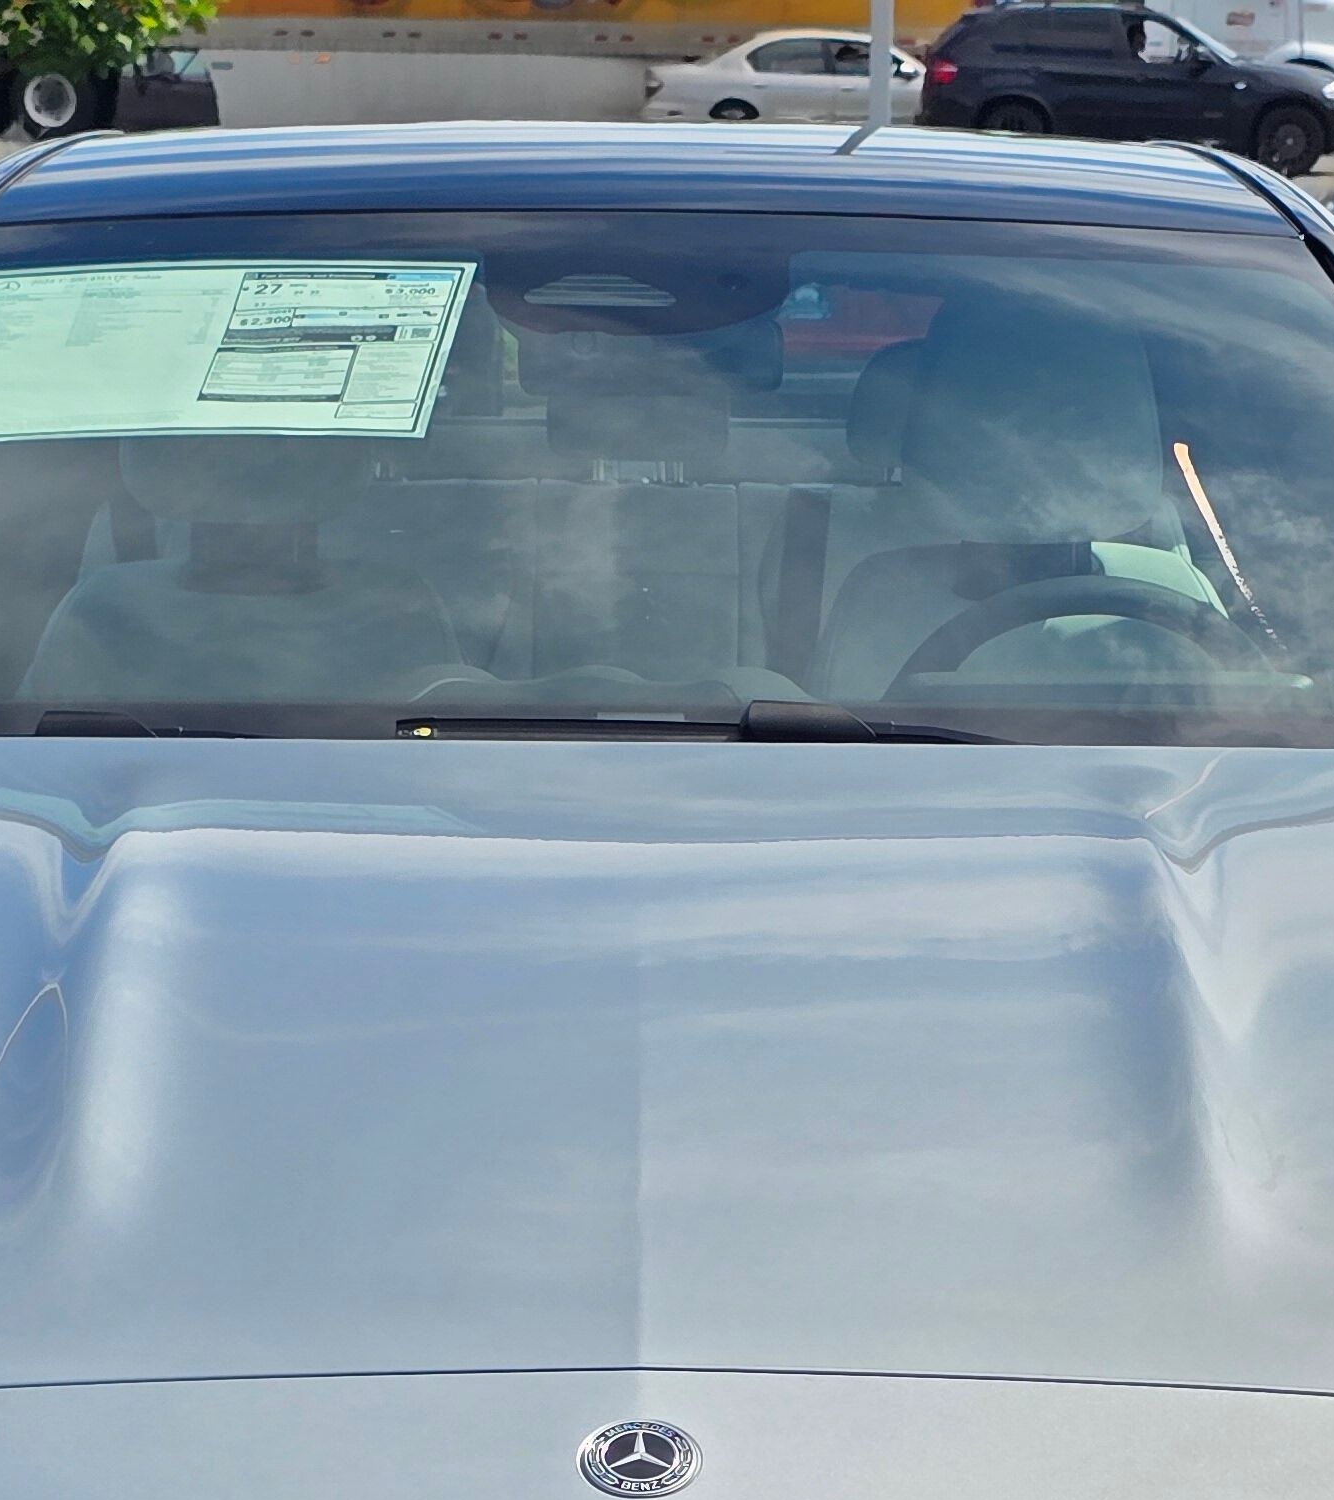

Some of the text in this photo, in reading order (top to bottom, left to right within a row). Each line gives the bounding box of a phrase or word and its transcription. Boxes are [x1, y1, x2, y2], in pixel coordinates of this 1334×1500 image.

[254, 283, 283, 296] 27
[604, 1421, 676, 1438] MERCEDES
[620, 1480, 662, 1492] BENZ
